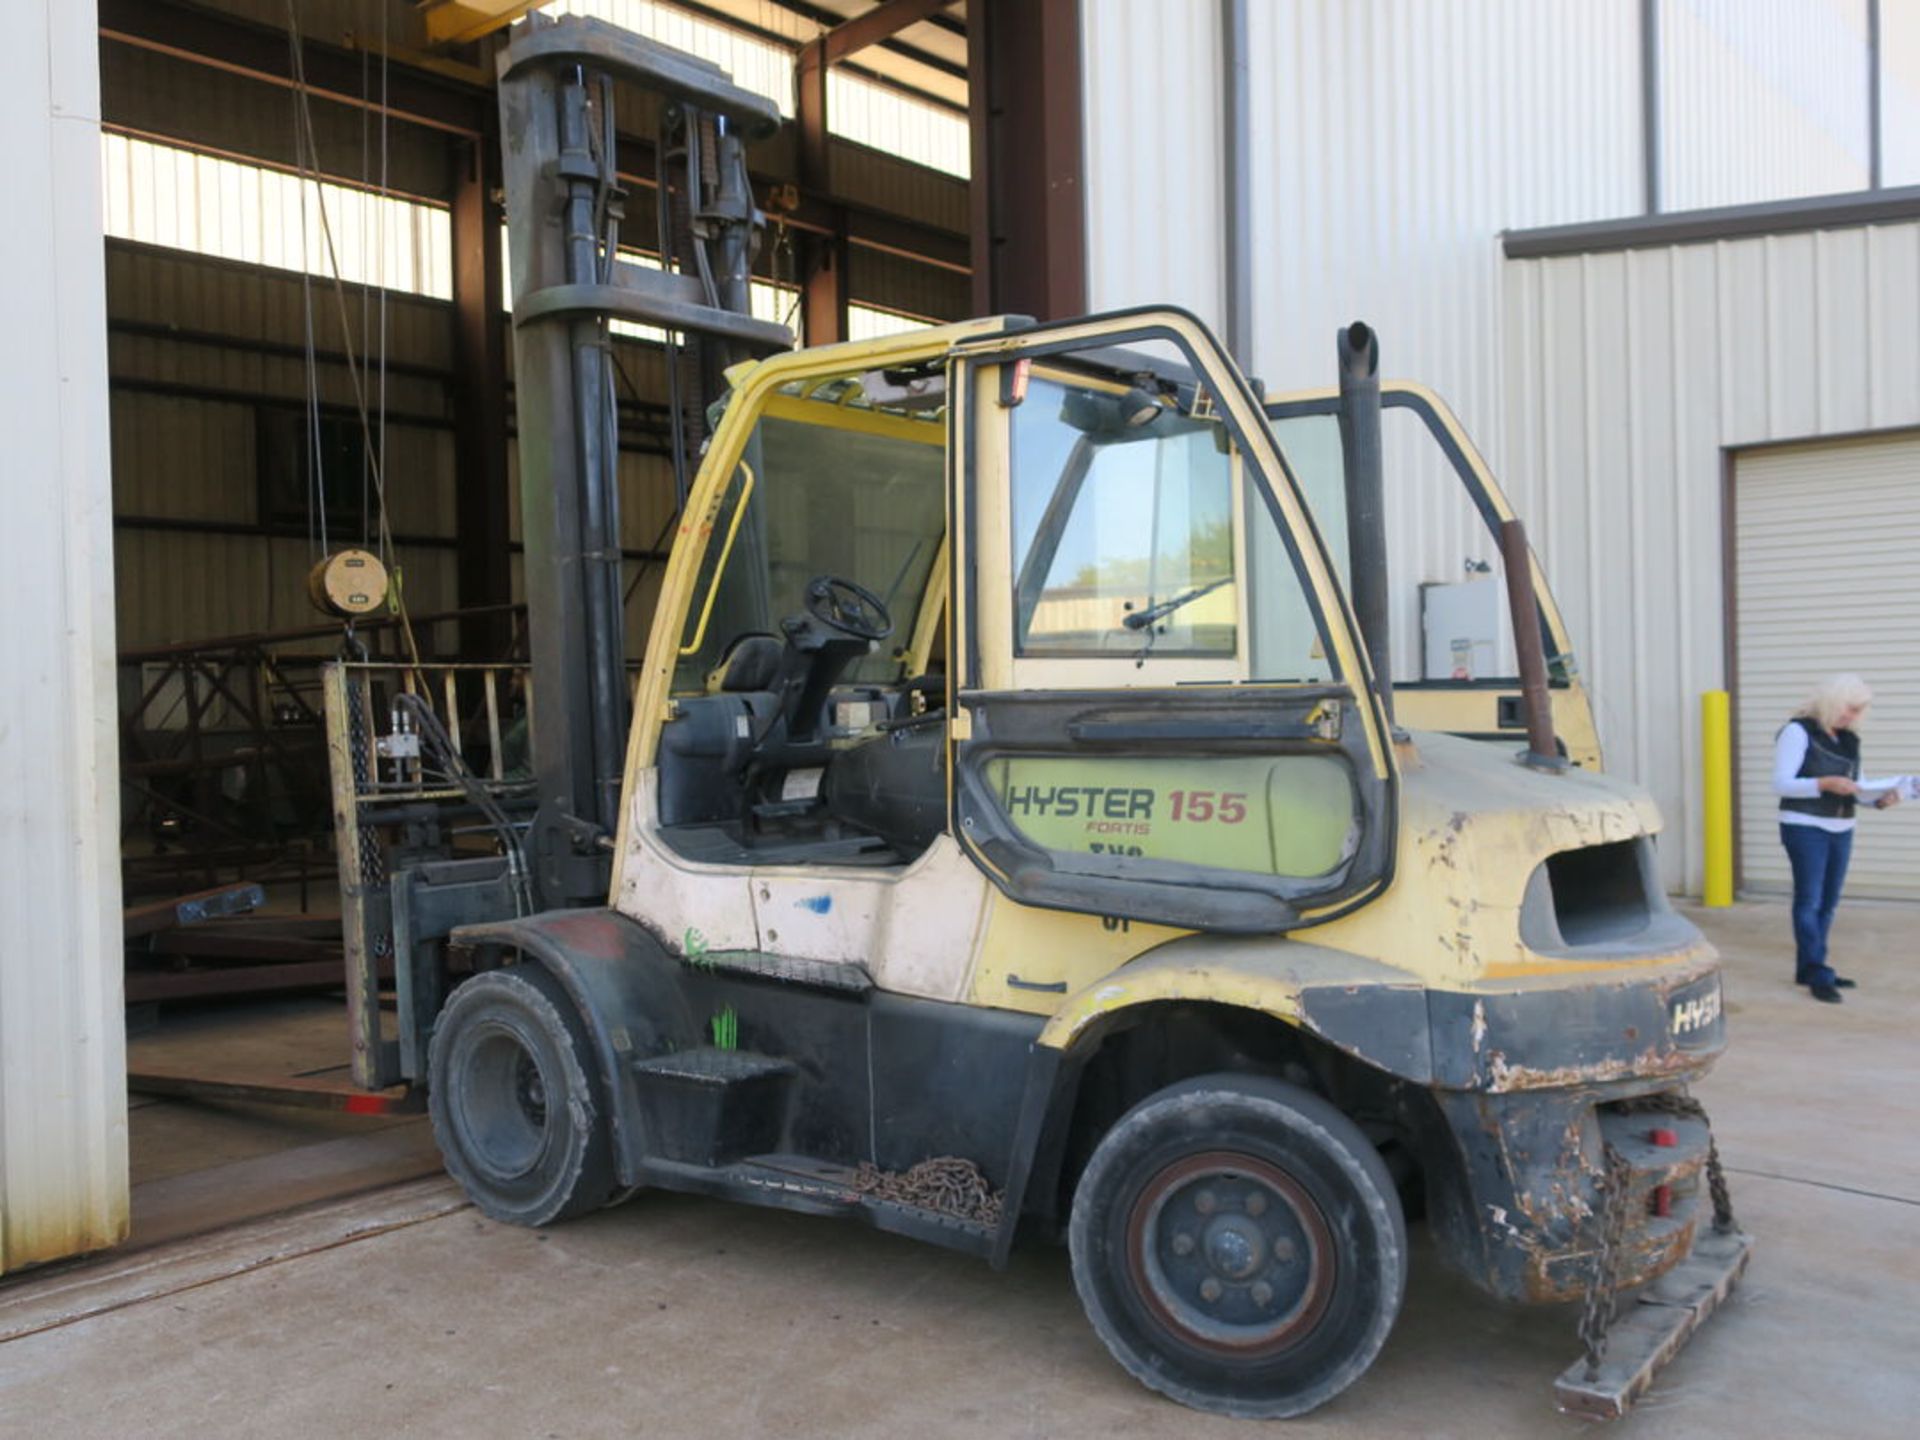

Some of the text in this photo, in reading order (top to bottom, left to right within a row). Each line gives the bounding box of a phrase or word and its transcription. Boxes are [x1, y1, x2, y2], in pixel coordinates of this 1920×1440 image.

[1008, 786, 1247, 823] HYSTER 155
[1086, 821, 1151, 835] FORTIS
